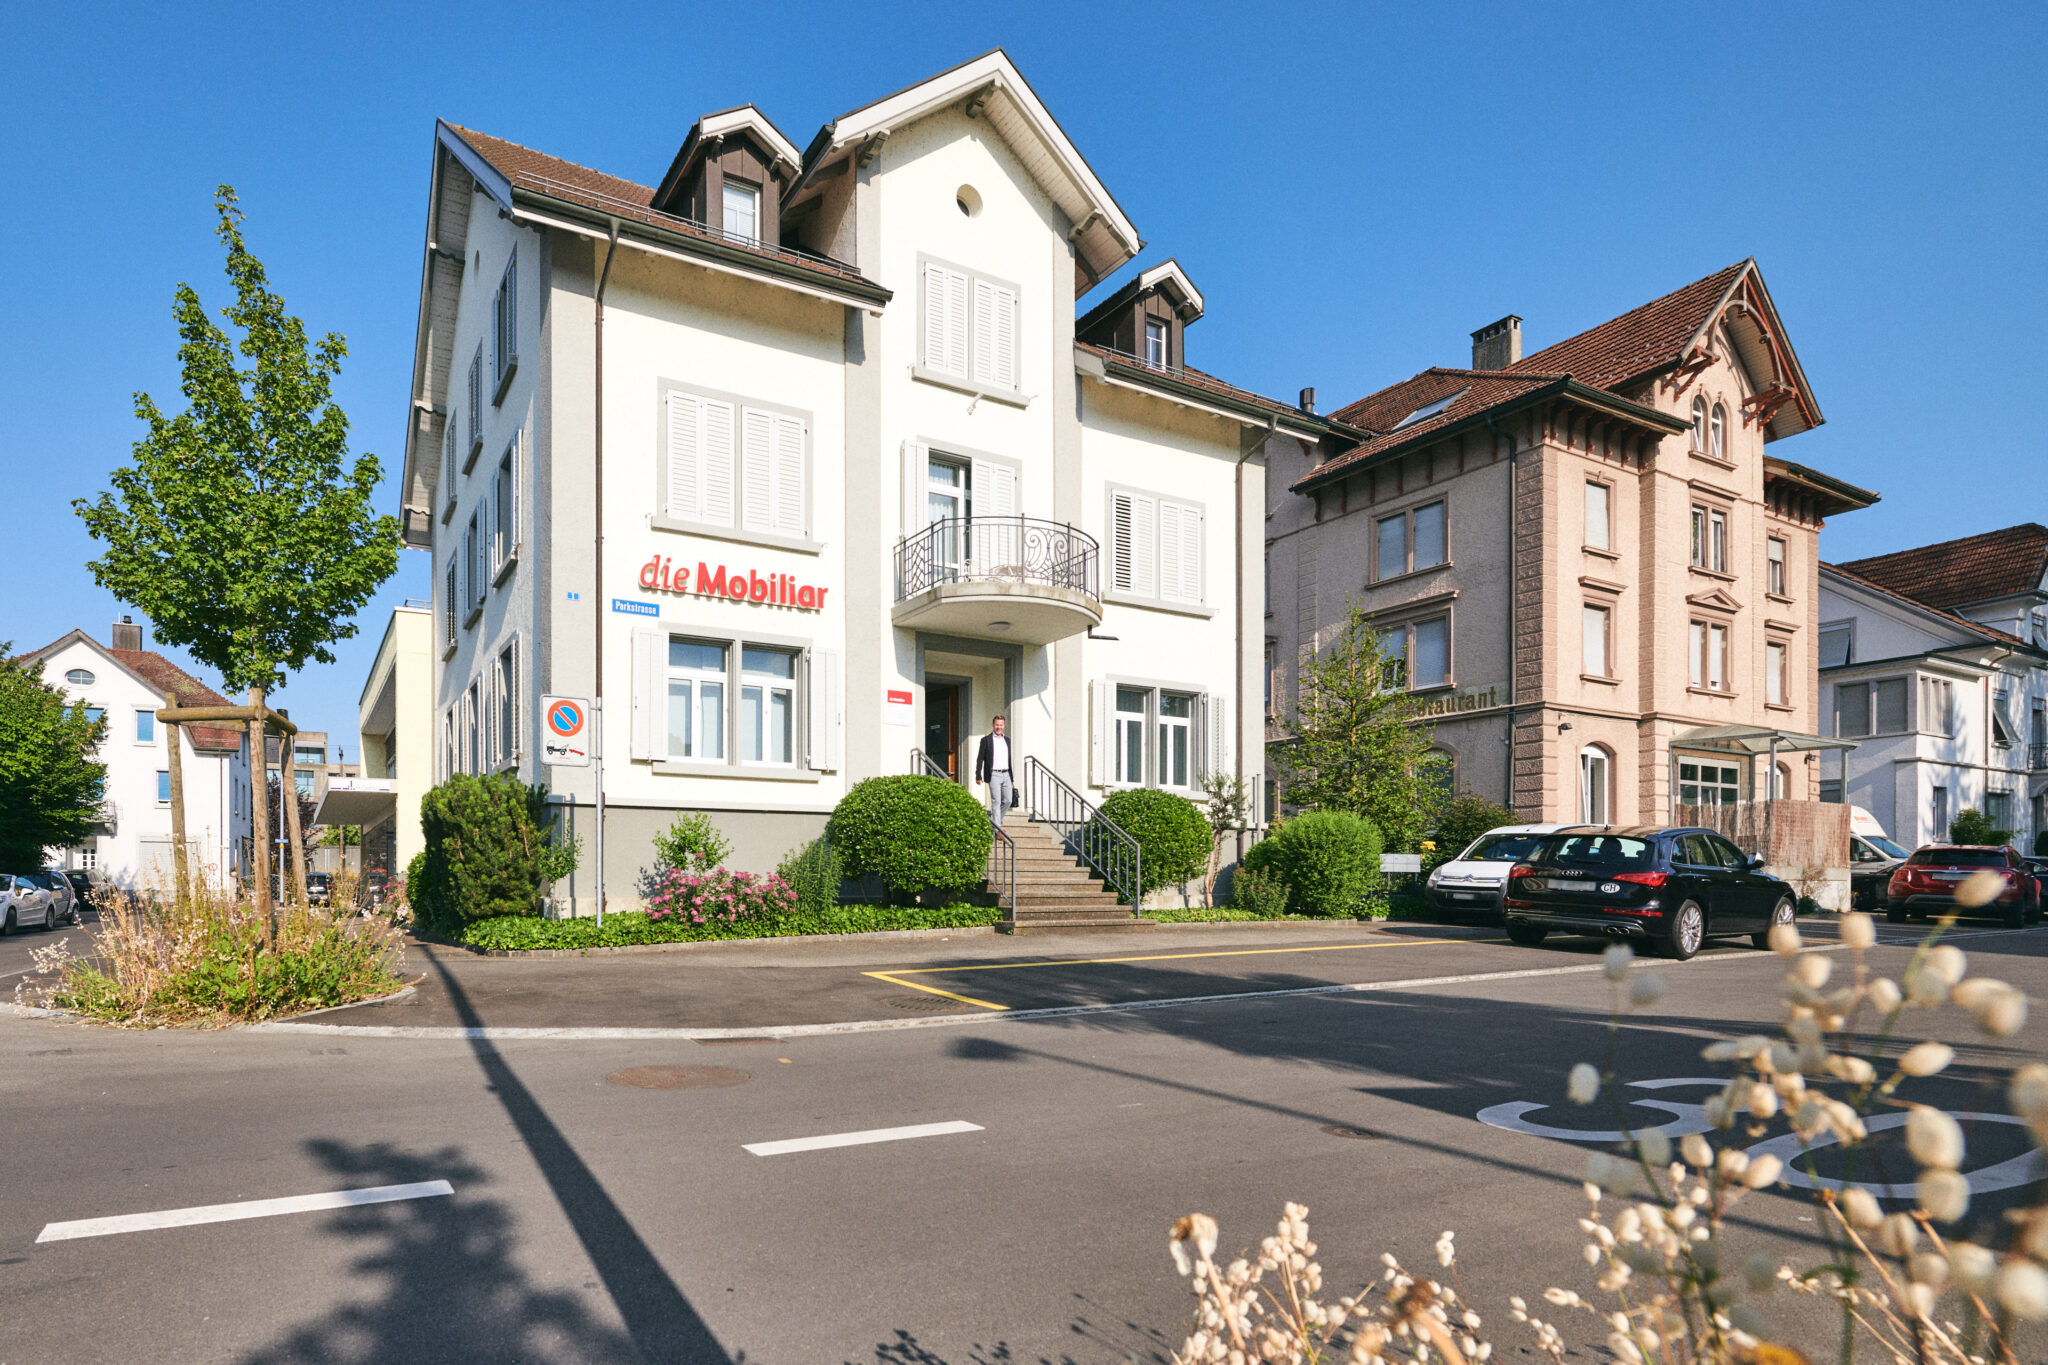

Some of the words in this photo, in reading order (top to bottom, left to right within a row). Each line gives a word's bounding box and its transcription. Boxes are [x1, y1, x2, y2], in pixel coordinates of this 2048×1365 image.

[639, 554, 690, 592] die
[696, 561, 829, 609] Mobiliar
[615, 600, 657, 615] Parkstrasse
